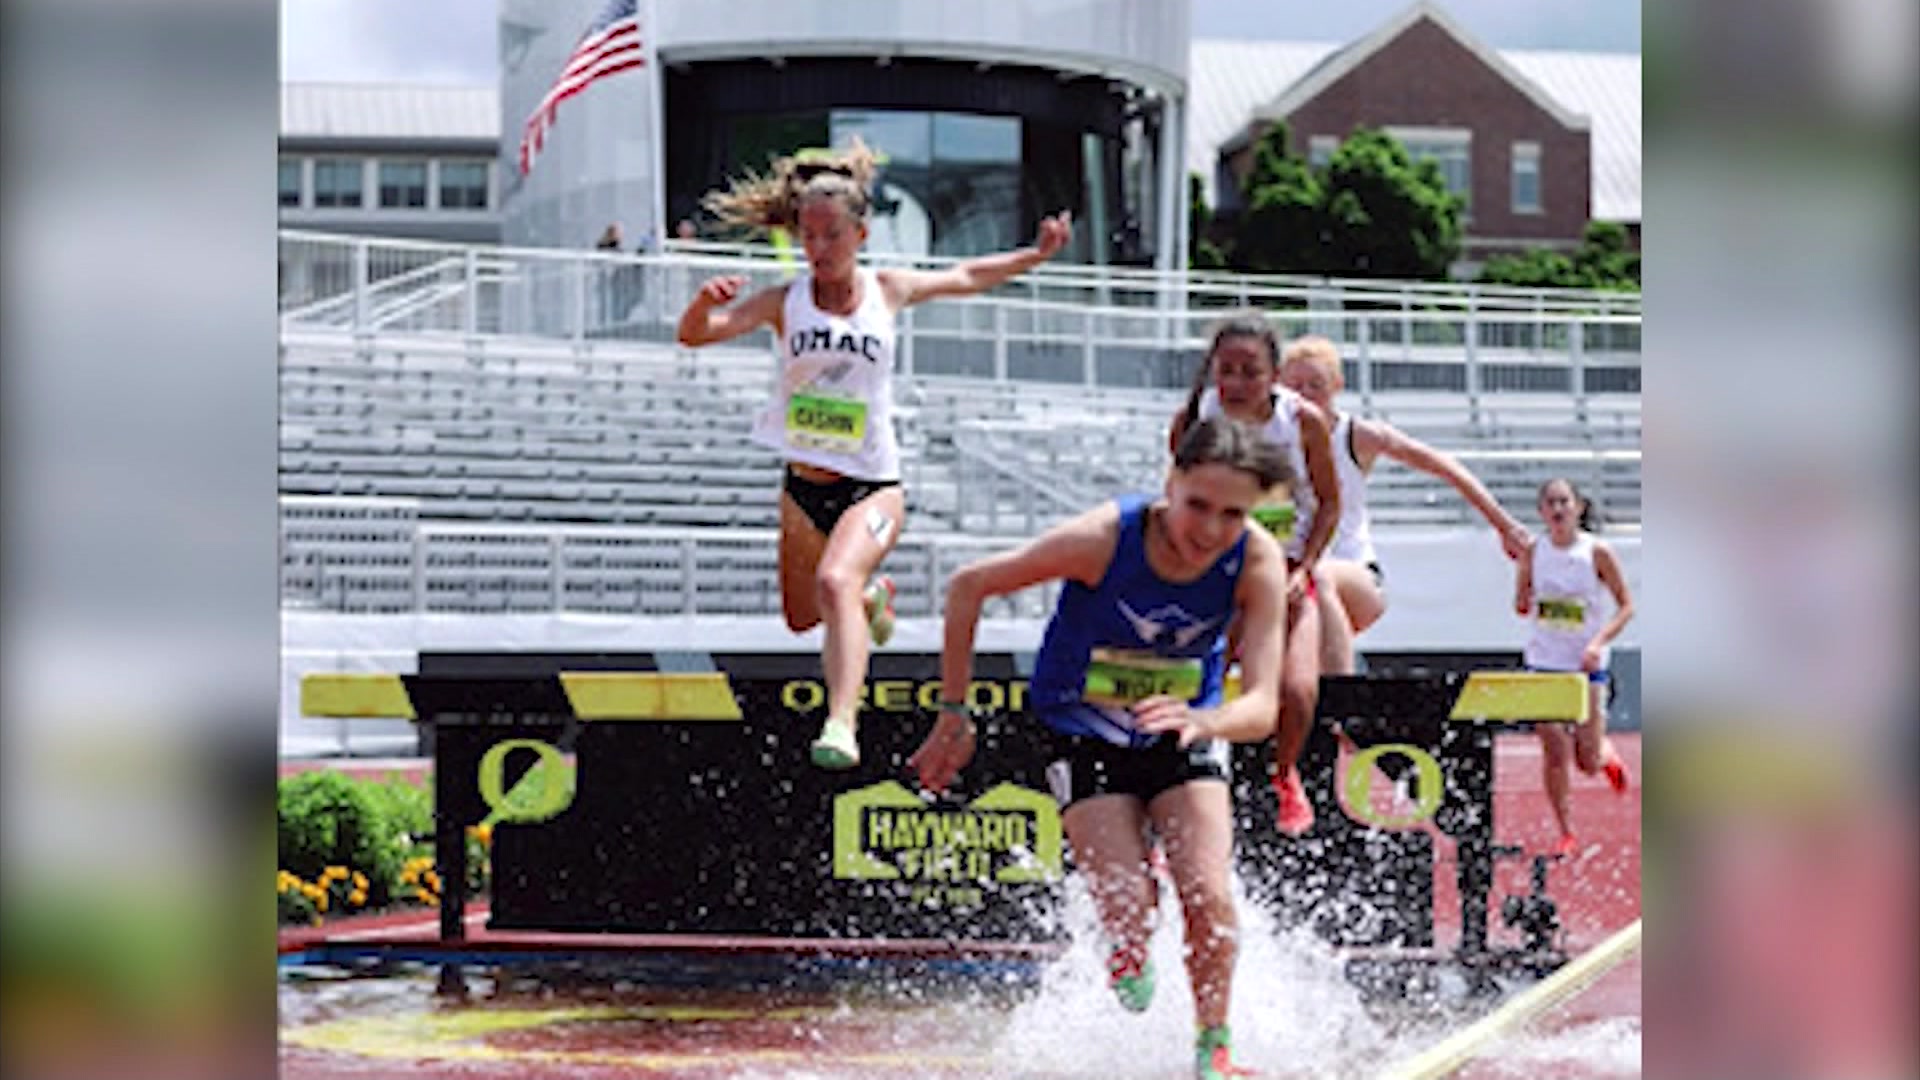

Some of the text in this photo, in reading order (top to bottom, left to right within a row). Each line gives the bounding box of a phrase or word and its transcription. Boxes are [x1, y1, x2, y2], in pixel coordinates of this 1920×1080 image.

[790, 326, 881, 362] UMAC
[781, 680, 1032, 712] OEGO
[868, 810, 1027, 851] HAYWARD
